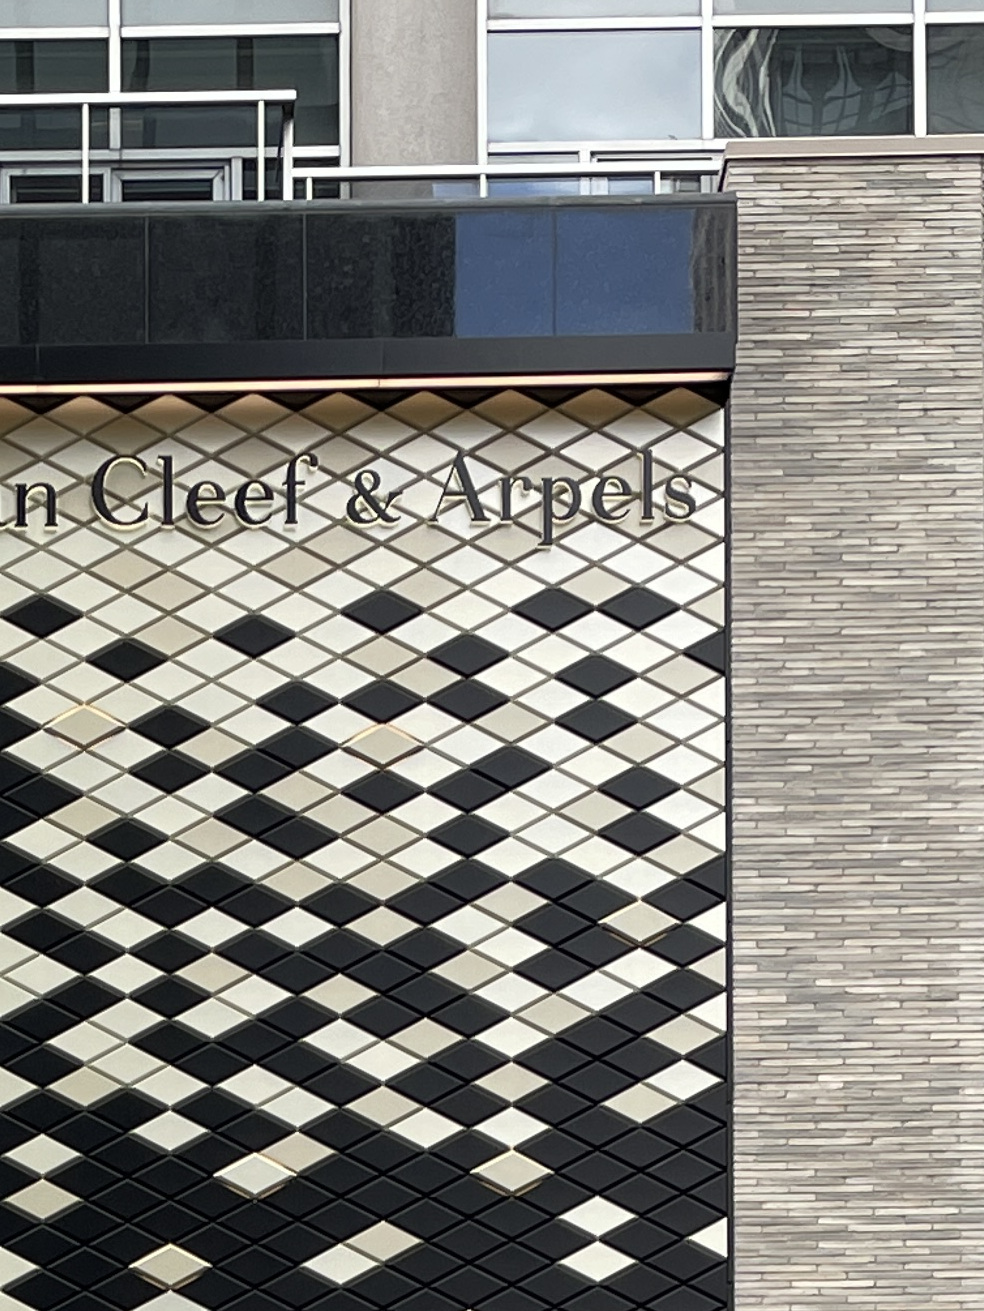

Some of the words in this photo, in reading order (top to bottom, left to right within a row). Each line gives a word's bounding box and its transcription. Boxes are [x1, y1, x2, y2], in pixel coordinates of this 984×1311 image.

[91, 452, 318, 530] Cleef
[345, 468, 404, 528] &
[428, 447, 698, 550] Arpels
